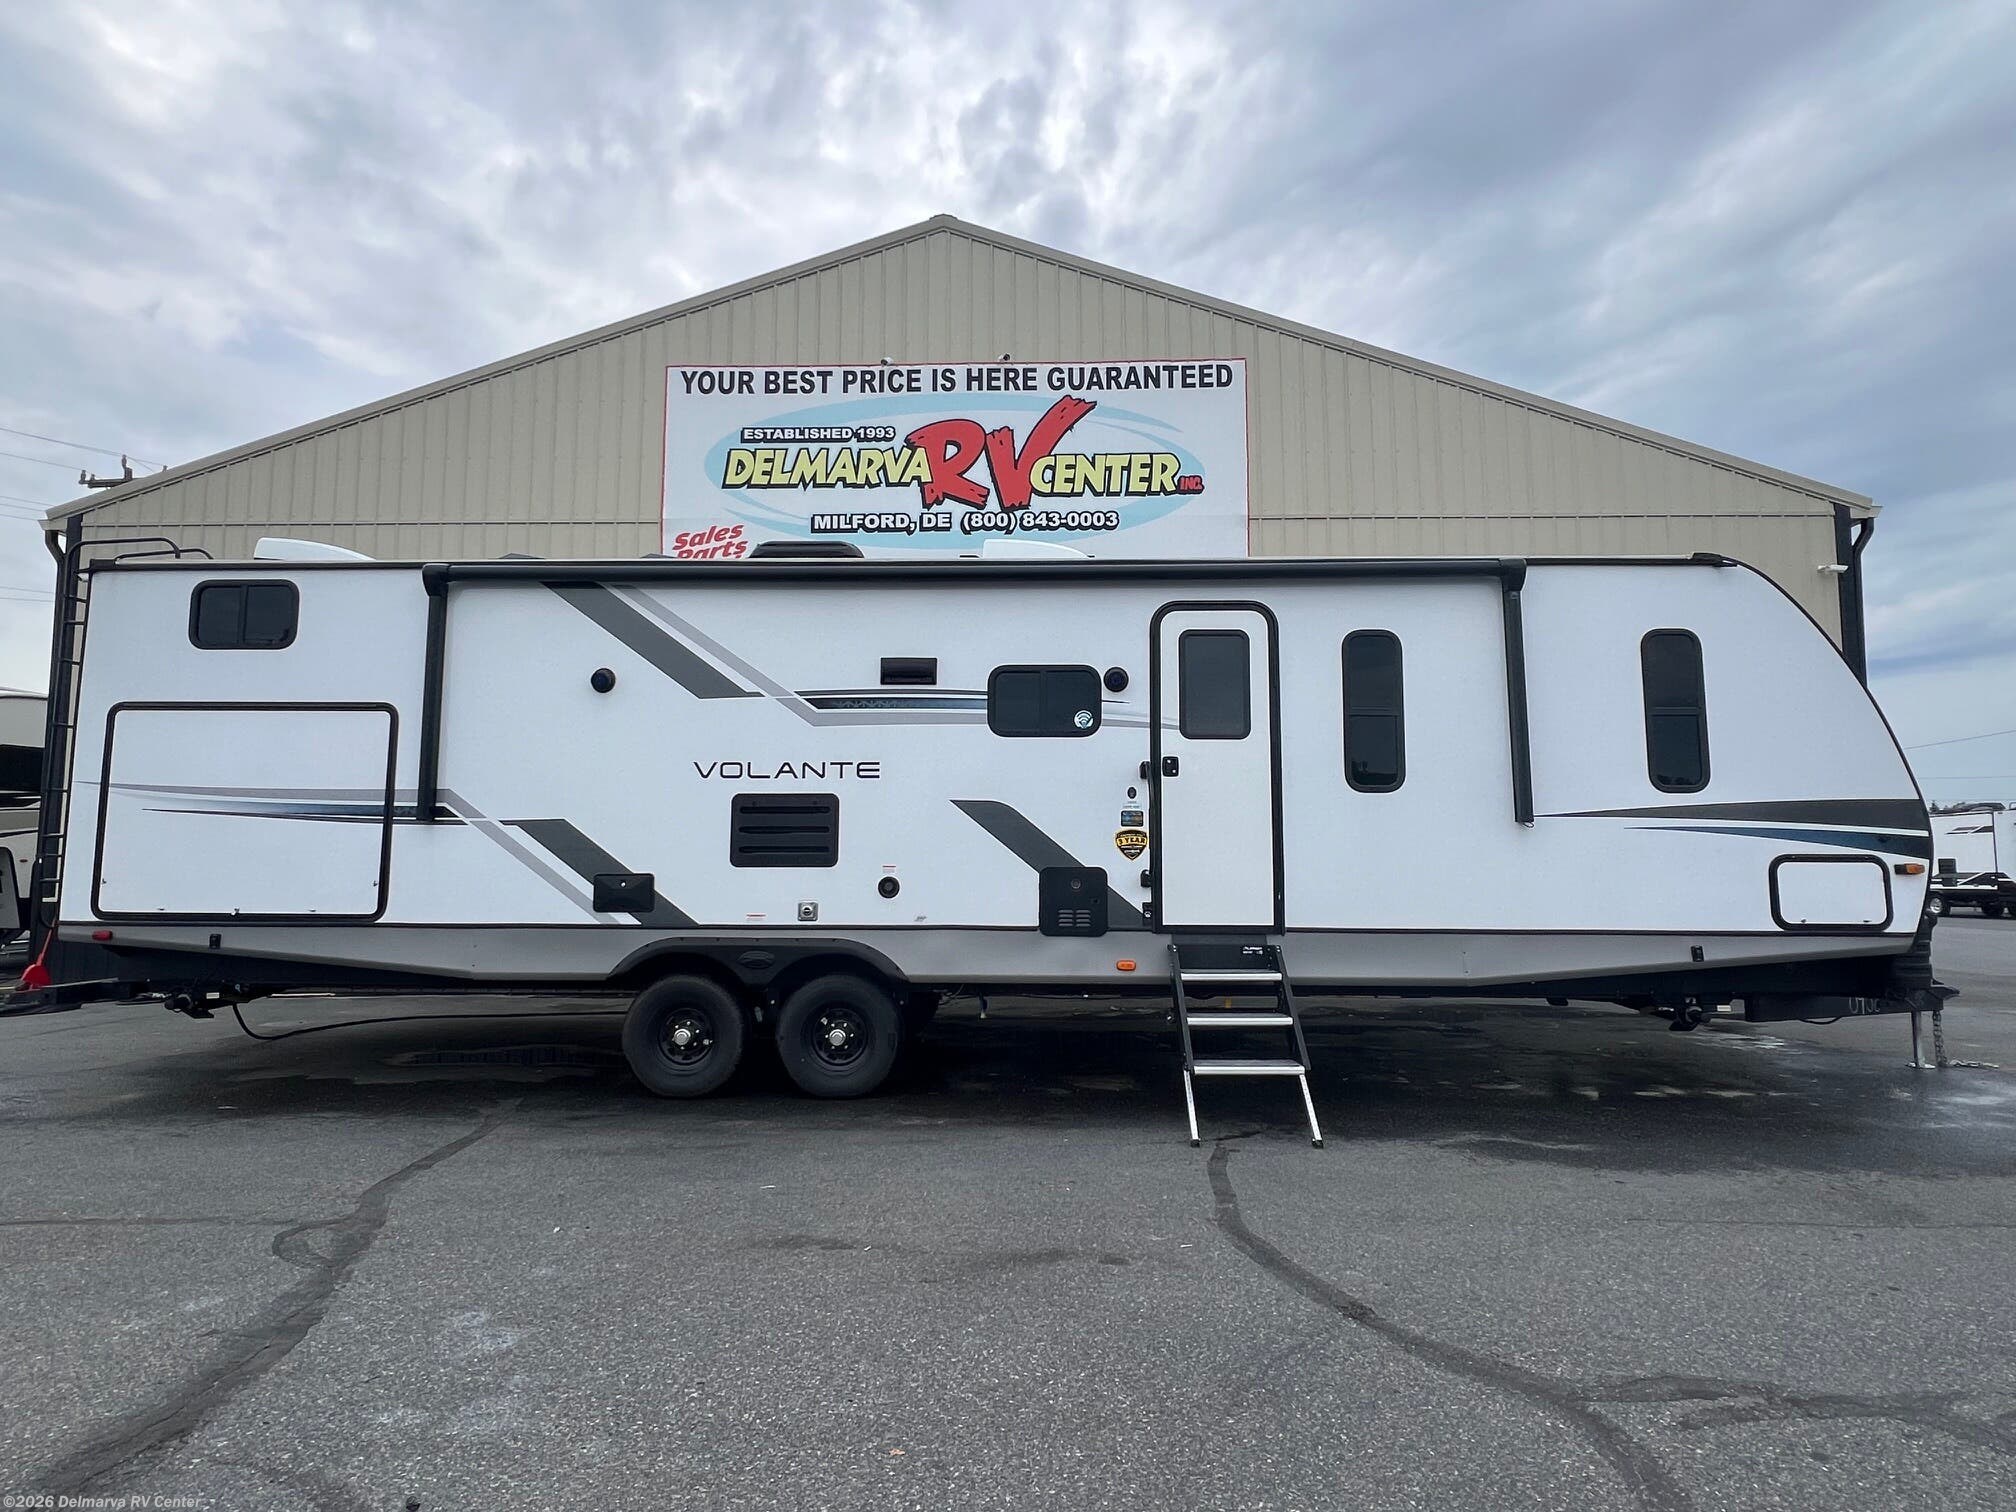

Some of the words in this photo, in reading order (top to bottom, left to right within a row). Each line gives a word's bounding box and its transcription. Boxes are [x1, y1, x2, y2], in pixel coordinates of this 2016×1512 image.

[681, 371, 755, 395] YOUR
[764, 370, 833, 394] BEST
[842, 369, 922, 394] PRICE
[932, 369, 956, 392] IS
[966, 368, 1037, 391] HERE
[1047, 364, 1233, 391] GUARANTEED
[743, 428, 853, 440] ESTABLISHED
[857, 427, 895, 440] 1993
[724, 446, 933, 489] DELMARVA
[904, 395, 1097, 512] RV
[1030, 453, 1180, 496] CENTER
[813, 514, 917, 531] MILFORD,
[922, 513, 951, 529] DE
[962, 512, 1017, 531] (800)
[1022, 512, 1118, 528] 843-0003
[672, 524, 745, 550] Sales
[693, 761, 881, 779] VOLANTE
